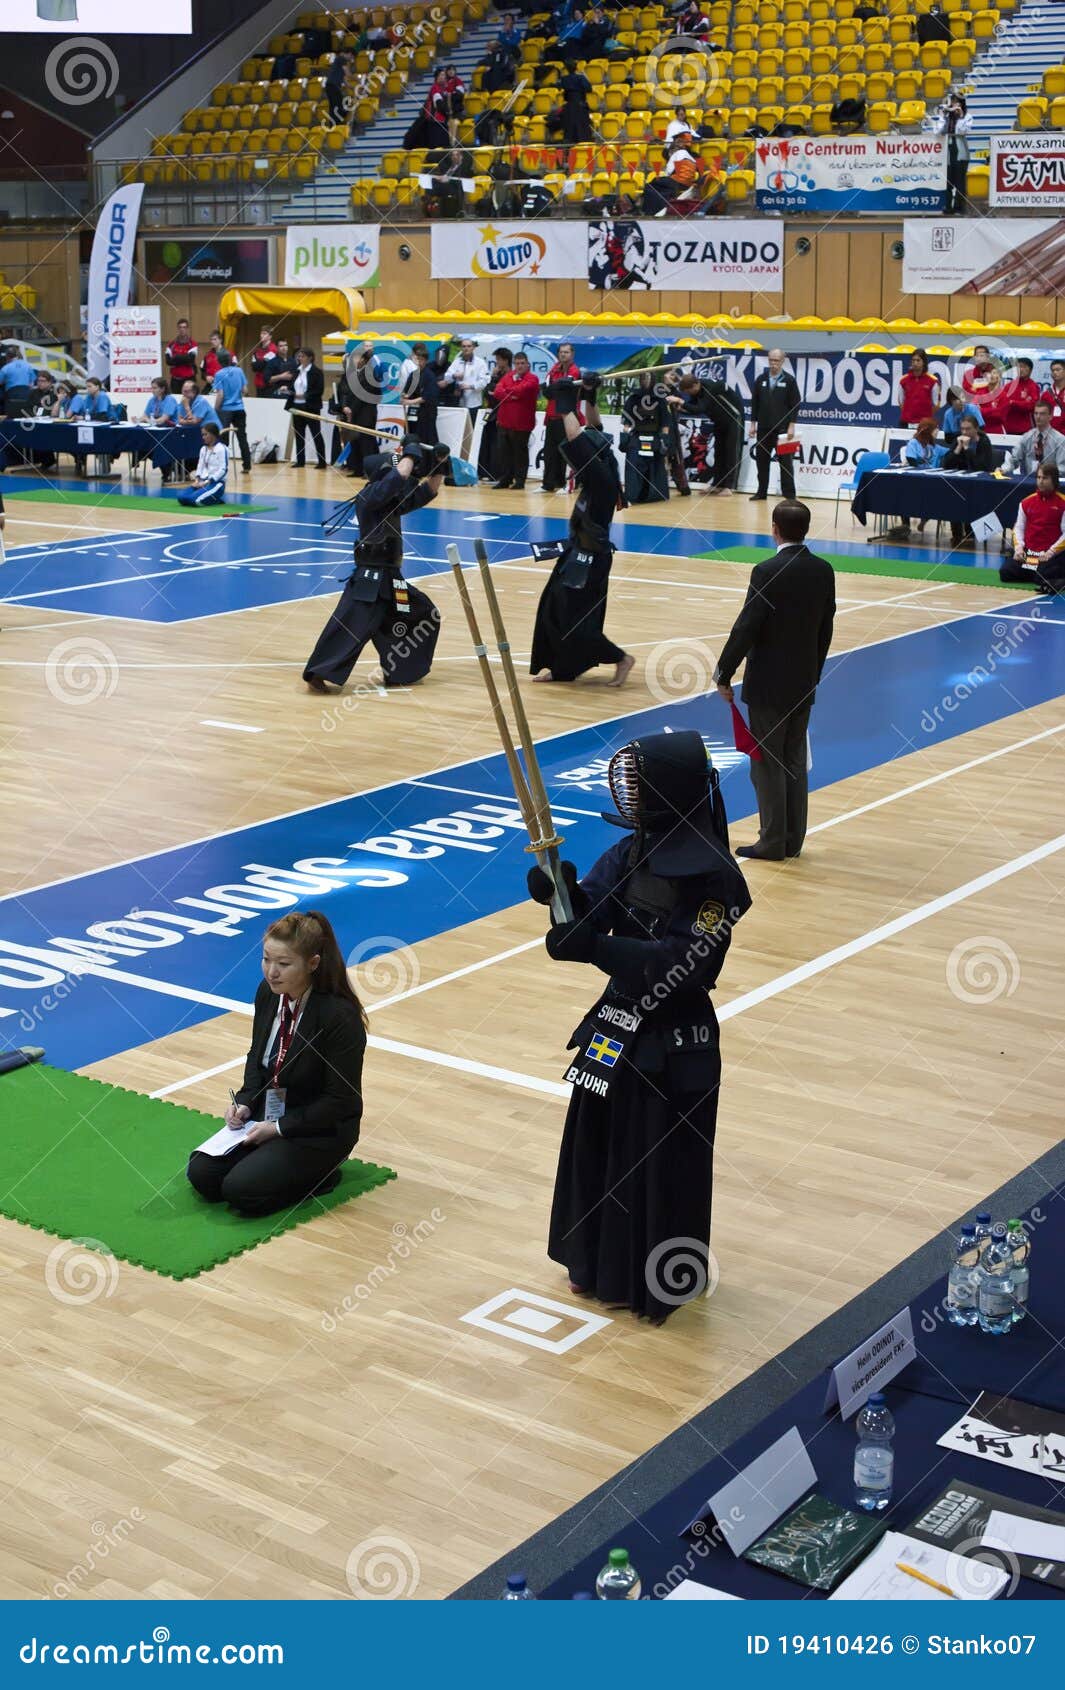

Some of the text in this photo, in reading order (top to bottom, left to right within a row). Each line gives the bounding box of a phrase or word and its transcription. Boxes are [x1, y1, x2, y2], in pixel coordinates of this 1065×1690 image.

[760, 141, 942, 156] oe Centrum Nurkowe
[762, 196, 775, 204] 601
[896, 196, 909, 204] 601
[911, 196, 920, 205] 19
[294, 238, 350, 276] plus
[486, 240, 533, 271] LOTTO
[649, 241, 780, 264] TOZANDO
[712, 265, 780, 274] KYOTO, JAPAN
[838, 469, 855, 477] JAP
[347, 803, 579, 860] Hala
[598, 1004, 644, 1033] SWEDEN
[673, 1025, 710, 1046] S 10
[565, 1066, 610, 1097] BJUHR
[914, 1490, 966, 1534] KENDO
[932, 1495, 978, 1537] EUROPEAN
